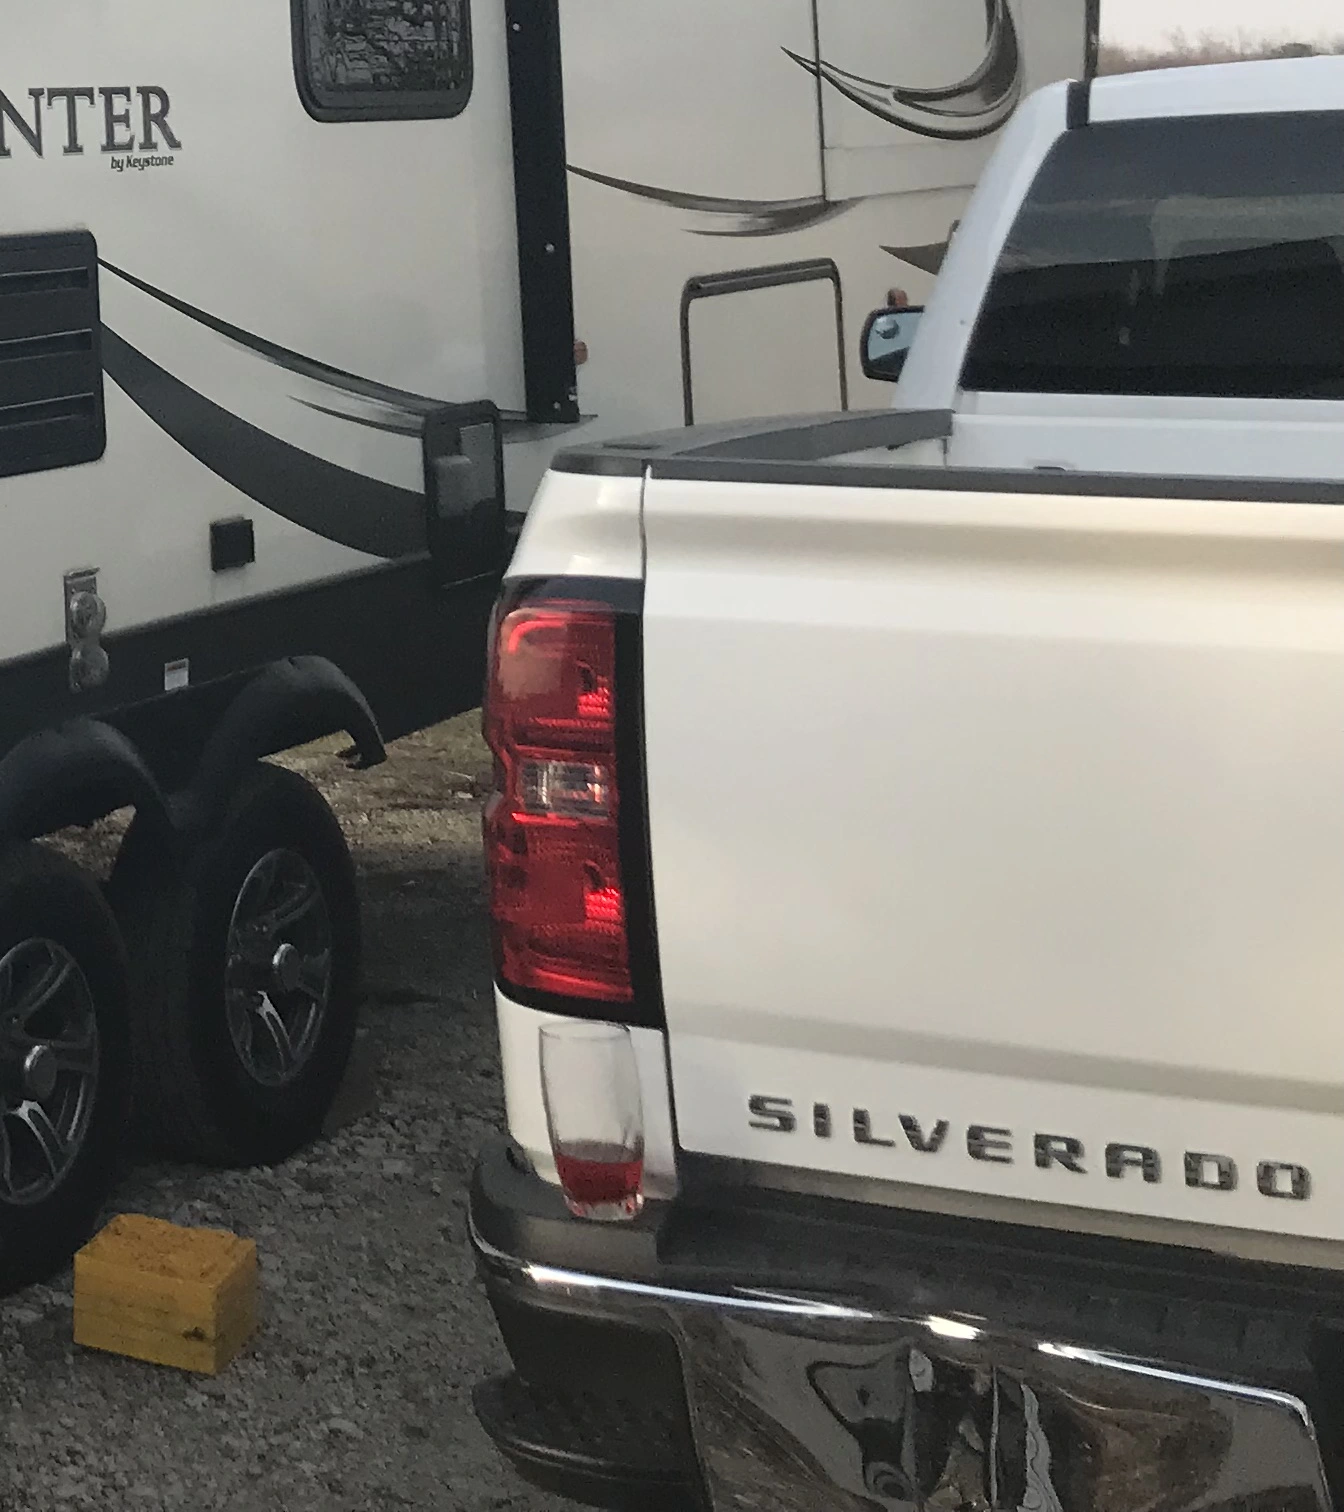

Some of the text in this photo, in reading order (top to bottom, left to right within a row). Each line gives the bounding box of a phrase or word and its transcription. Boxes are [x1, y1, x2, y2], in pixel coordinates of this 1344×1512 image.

[110, 154, 175, 172] by Keystone
[748, 1094, 1312, 1200] SILVERADO
